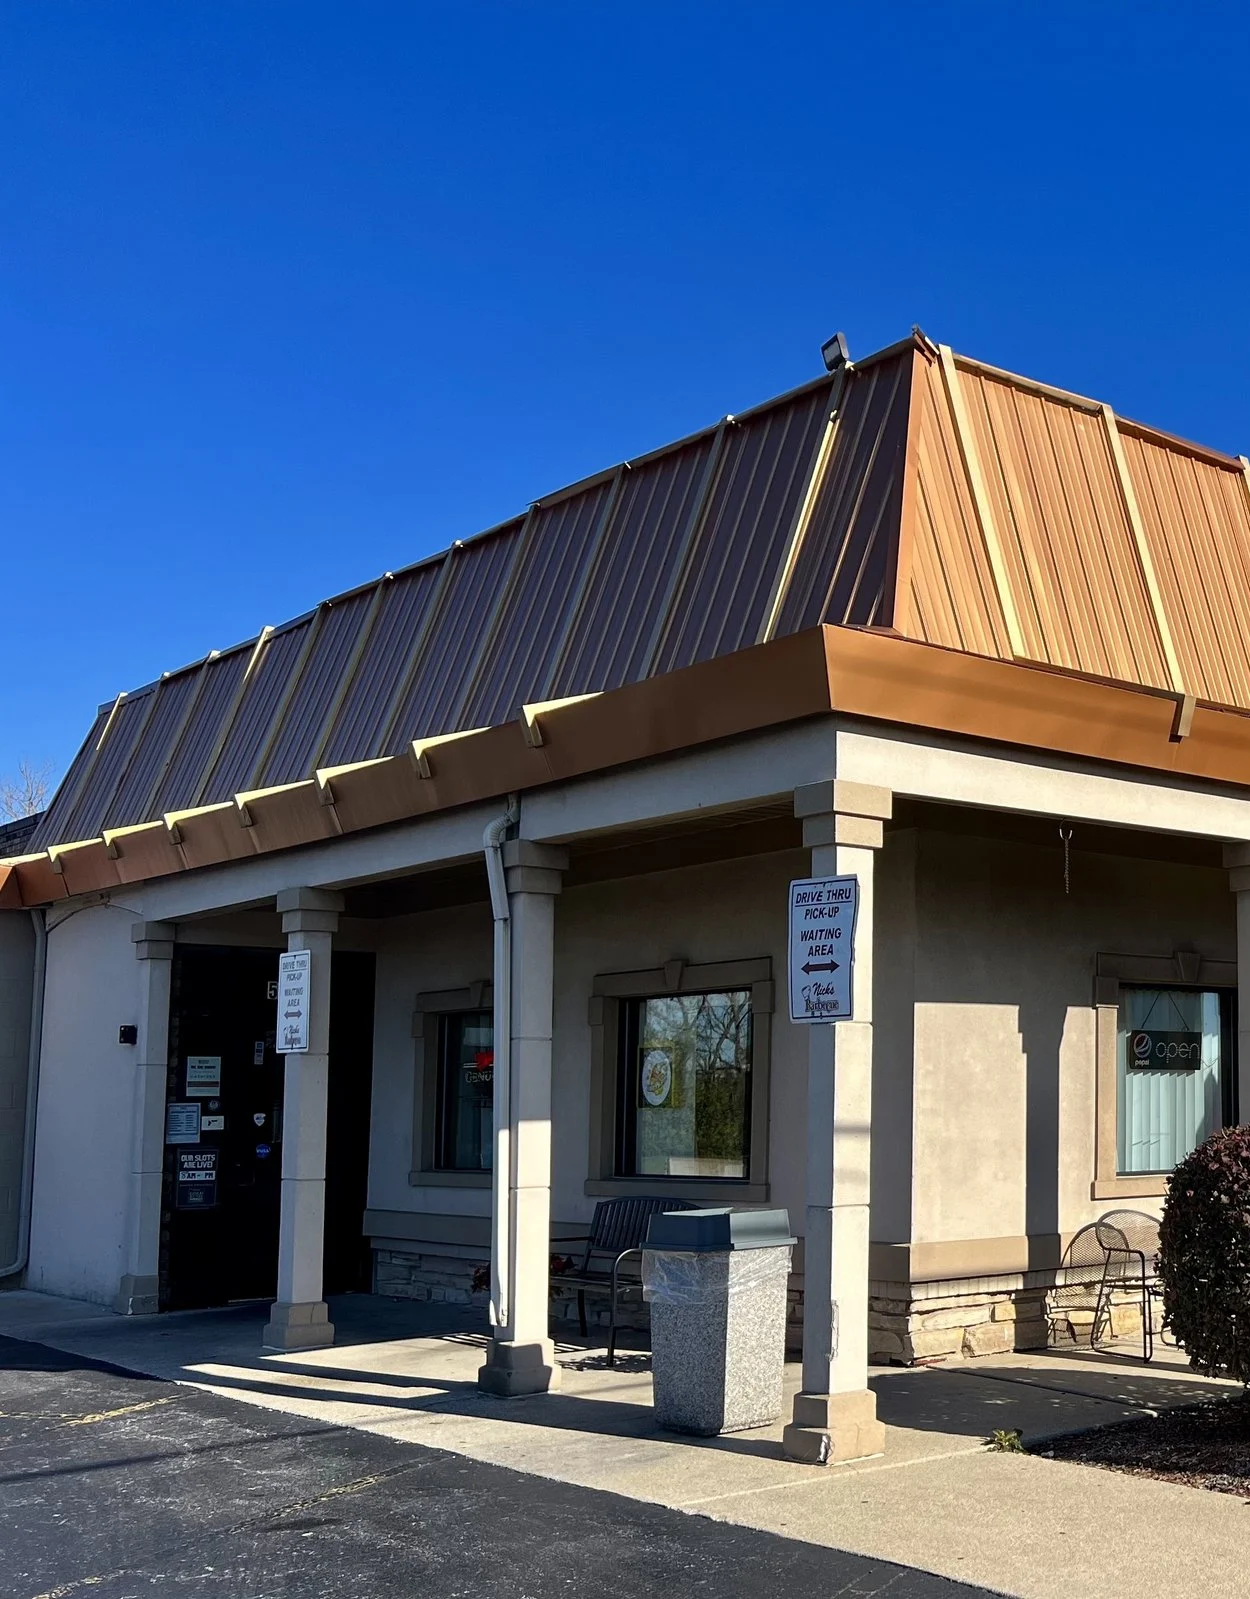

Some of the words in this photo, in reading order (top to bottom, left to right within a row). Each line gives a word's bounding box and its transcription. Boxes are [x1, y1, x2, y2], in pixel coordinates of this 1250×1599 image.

[795, 890, 823, 904] DRIVE
[827, 887, 852, 901] THRU
[804, 906, 840, 920] PICK-UP
[800, 927, 842, 942] WAITING
[808, 943, 835, 958] AREA
[812, 981, 836, 997] Nick's
[1155, 1041, 1201, 1064] open
[180, 1154, 194, 1162] OUR
[194, 1153, 216, 1162] SLOTS
